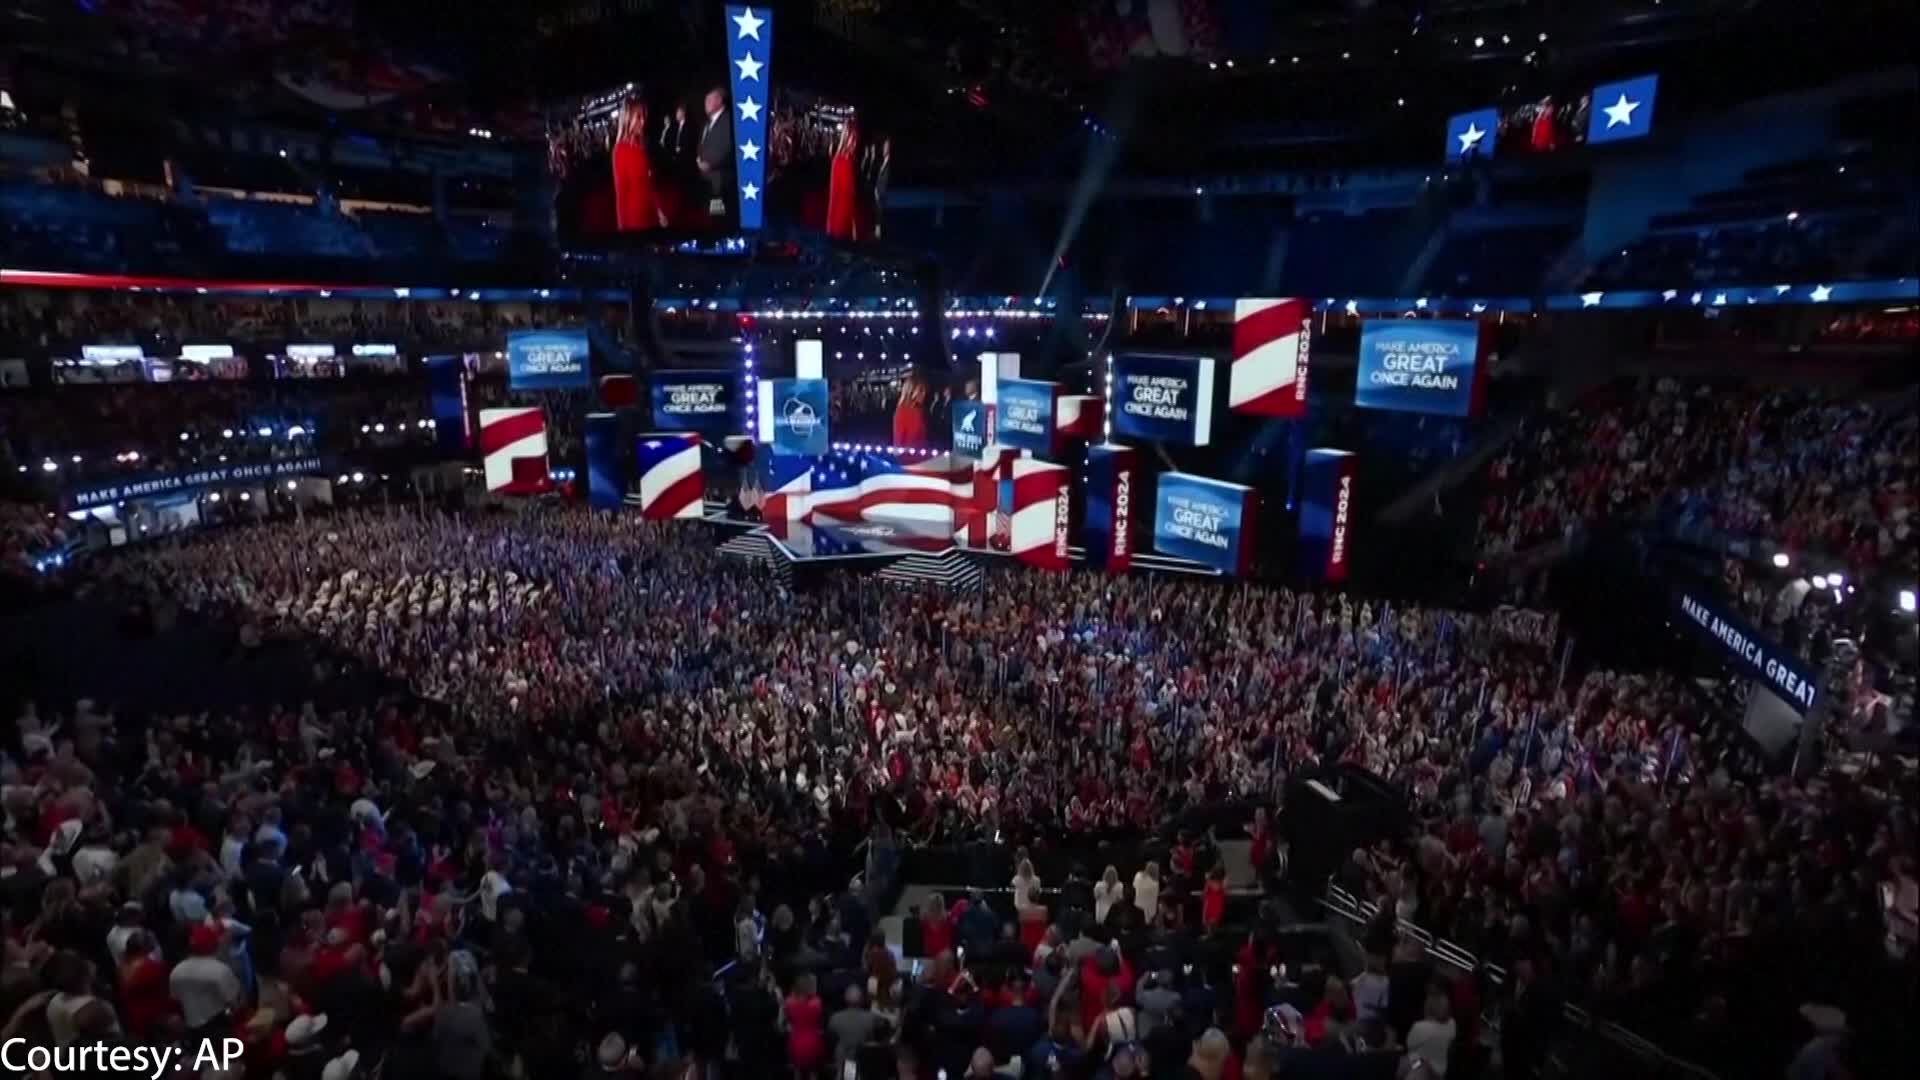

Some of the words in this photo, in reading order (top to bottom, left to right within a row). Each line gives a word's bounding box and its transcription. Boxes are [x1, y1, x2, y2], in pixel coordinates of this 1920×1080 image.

[1299, 318, 1312, 364] 2024
[1408, 343, 1460, 355] AMERICA
[527, 351, 572, 363] GREAT
[1383, 353, 1448, 373] GREAT
[1370, 370, 1408, 386] ONCE
[1411, 375, 1458, 390] AGAIN
[671, 391, 717, 404] GREAT
[1133, 386, 1180, 406] GREAT
[1154, 406, 1188, 420] AGAIN
[77, 487, 117, 505] MAKE
[123, 477, 182, 496] AMERICA
[185, 469, 228, 485] GREAT
[232, 464, 272, 478] ONCE
[1117, 470, 1131, 518] 2024
[1057, 485, 1070, 525] 2024
[1336, 475, 1352, 524] 2024
[1173, 507, 1222, 532] GREAT
[1194, 531, 1229, 550] AGAIN
[1681, 594, 1711, 629] MAKE
[1710, 616, 1763, 670] AMERICA
